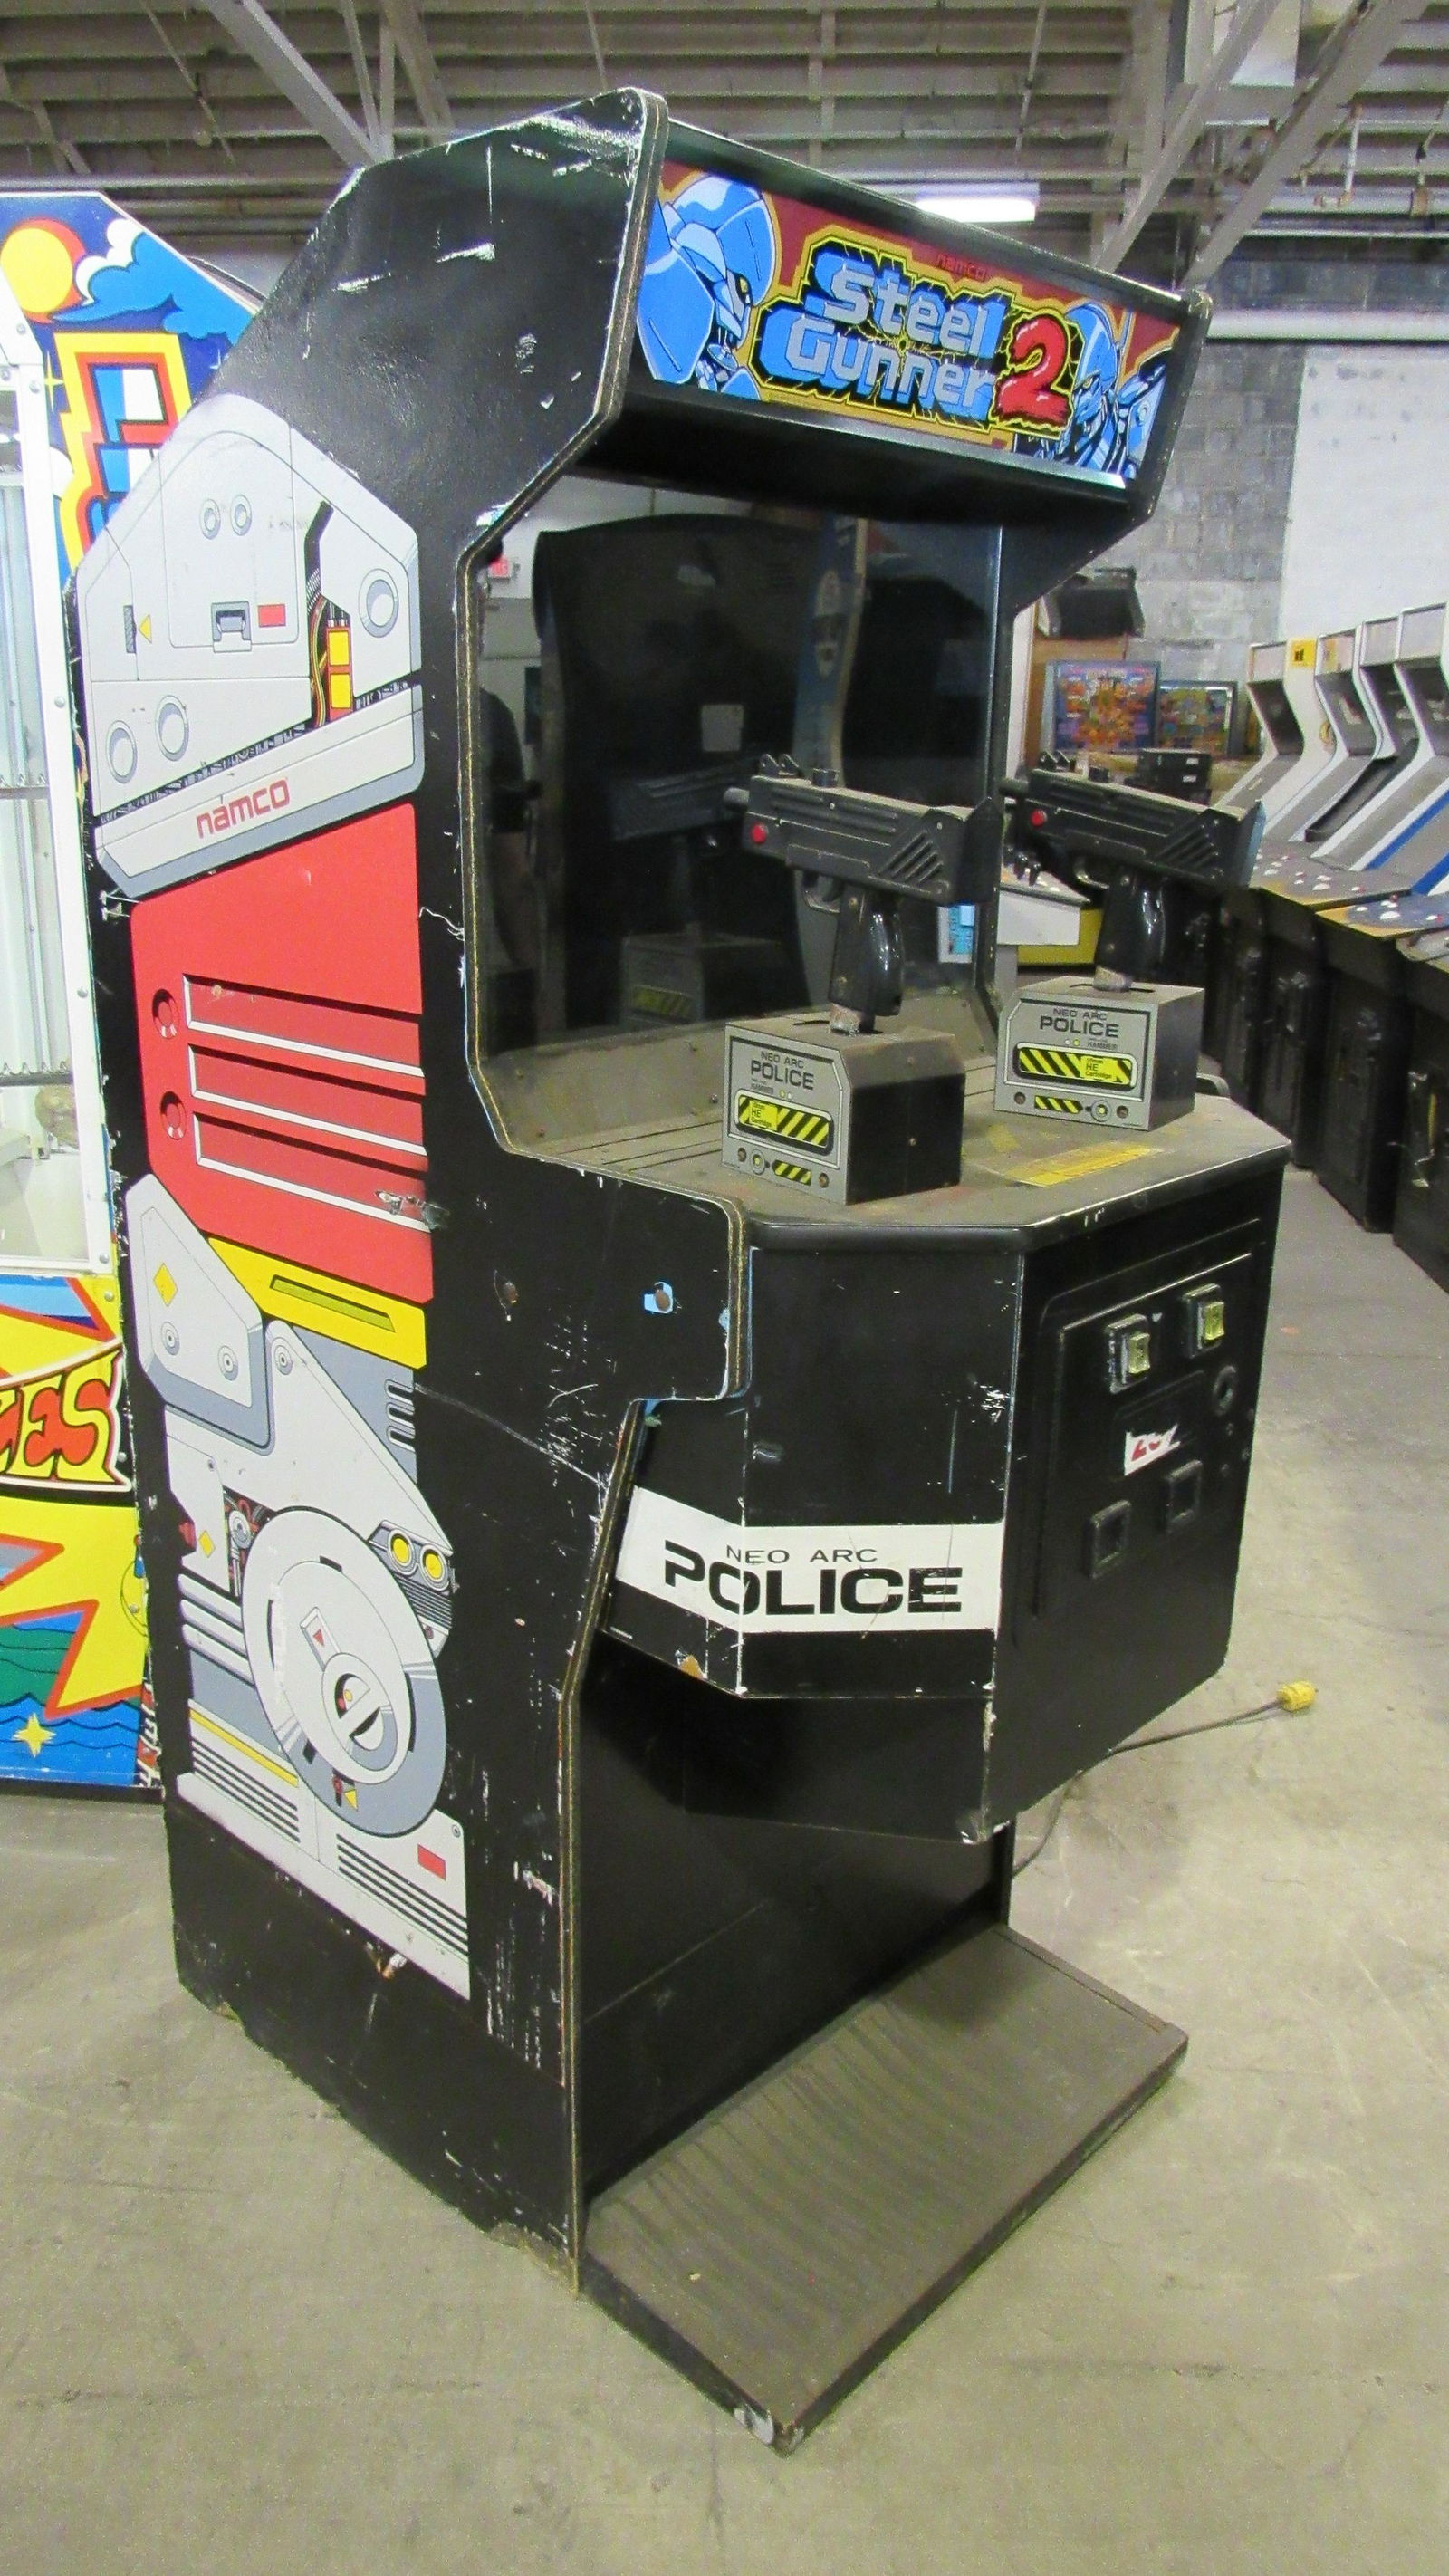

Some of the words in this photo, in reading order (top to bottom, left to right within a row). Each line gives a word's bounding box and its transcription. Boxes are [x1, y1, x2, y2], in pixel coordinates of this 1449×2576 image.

[816, 251, 1005, 359] Steel
[763, 308, 997, 419] Gunner
[996, 313, 1072, 428] 2
[197, 778, 291, 838] namco
[1040, 1015, 1119, 1038] POLICE
[1053, 1007, 1078, 1018] NEO
[1082, 1011, 1107, 1021] ARC
[761, 1051, 781, 1063] NEO
[783, 1056, 804, 1069] ARC
[1086, 1063, 1099, 1072] HE
[751, 1059, 815, 1091] POLICE
[725, 1544, 790, 1564] NEO
[809, 1548, 878, 1563] ARC
[664, 1539, 963, 1616] POLICE
